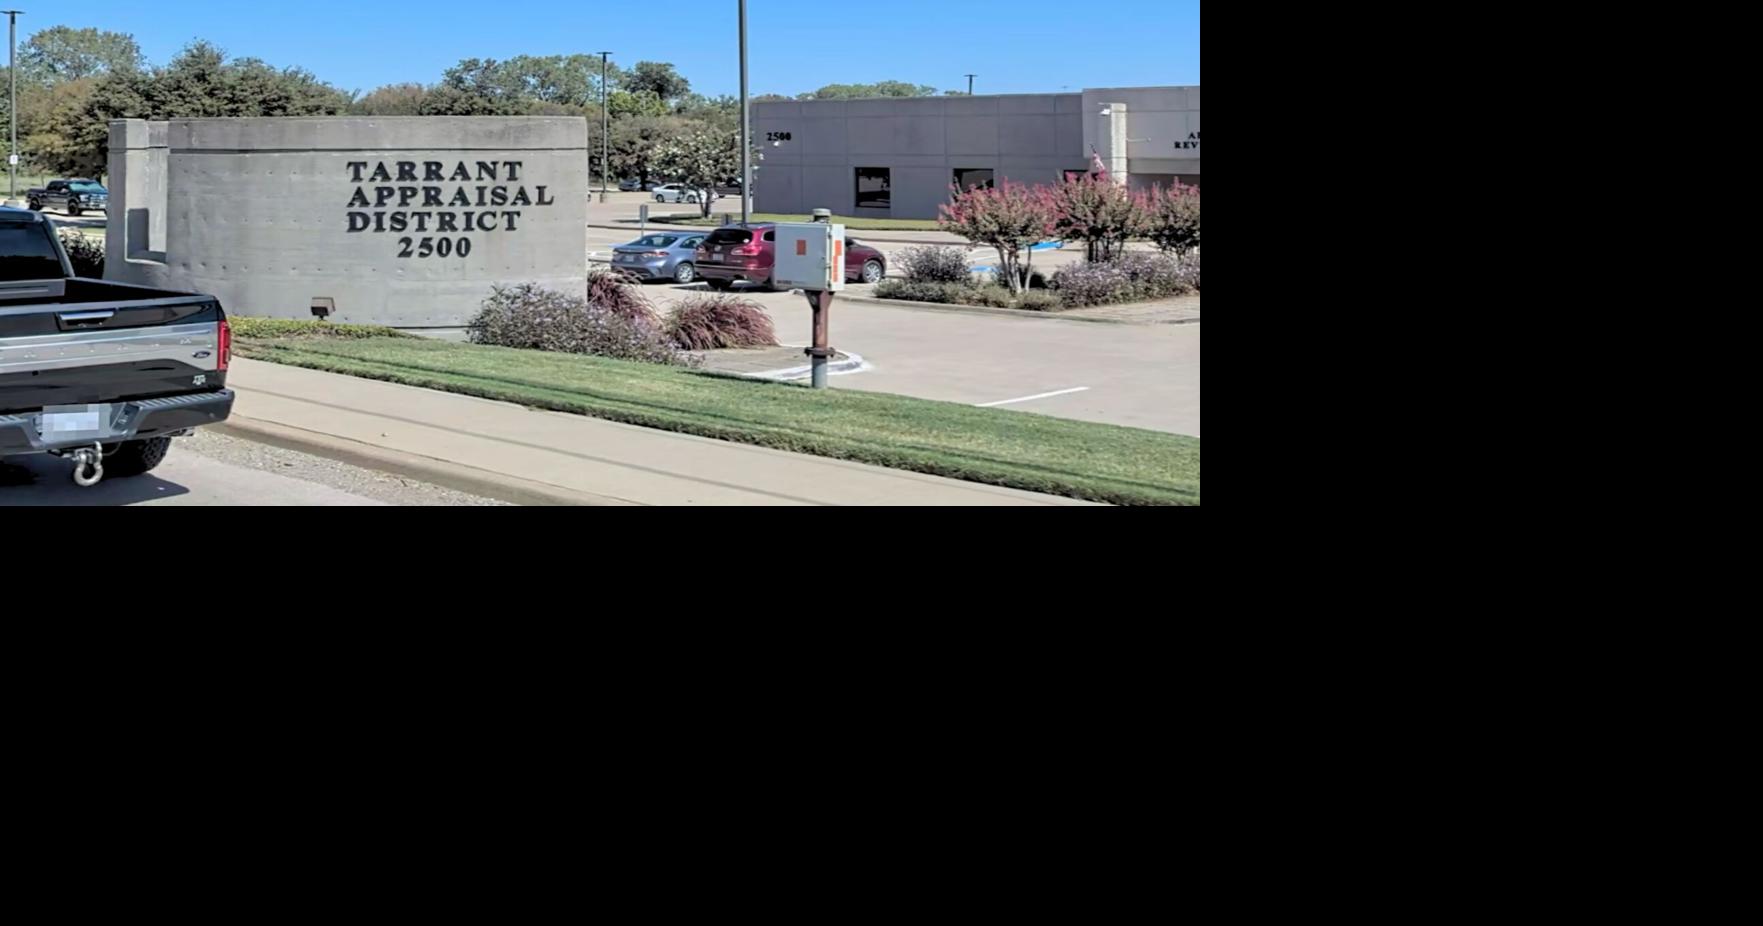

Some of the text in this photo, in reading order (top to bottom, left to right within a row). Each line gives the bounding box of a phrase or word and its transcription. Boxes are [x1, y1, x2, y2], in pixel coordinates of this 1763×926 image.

[766, 132, 792, 141] 2500
[347, 161, 523, 182] TARRANT
[346, 186, 555, 207] APPRAISAL
[346, 211, 521, 232] DISTRICT
[397, 236, 471, 258] 2500
